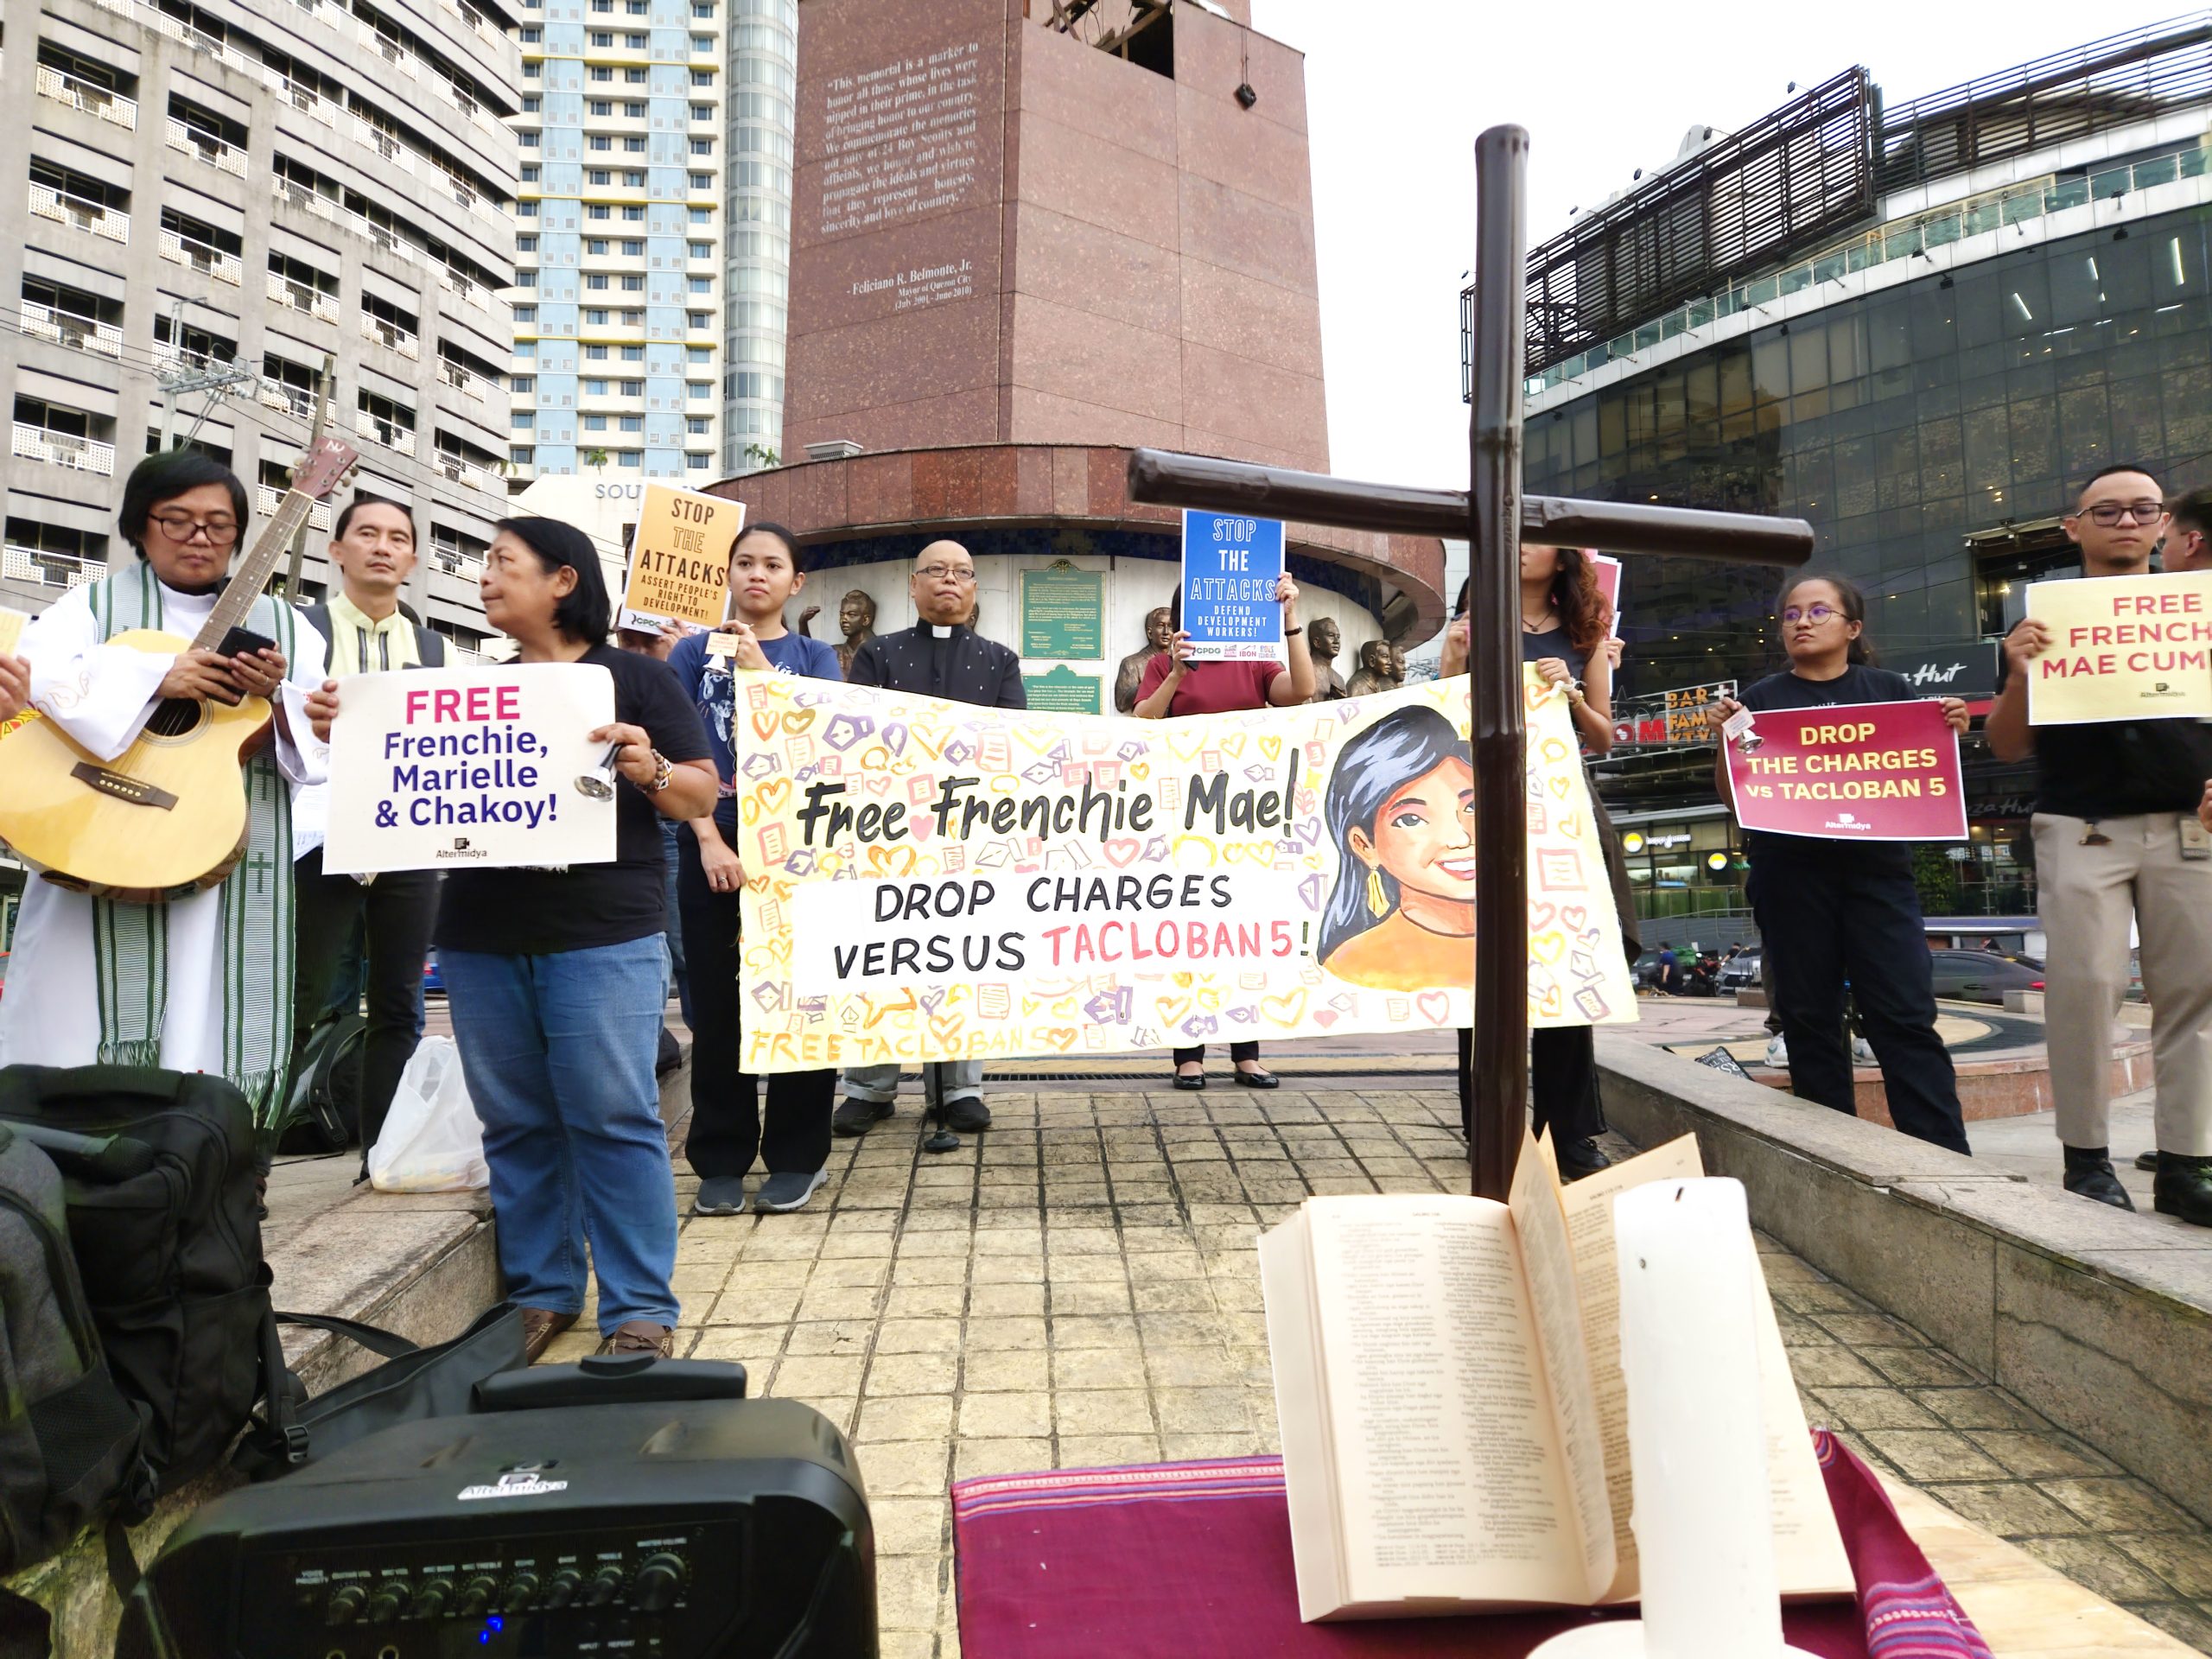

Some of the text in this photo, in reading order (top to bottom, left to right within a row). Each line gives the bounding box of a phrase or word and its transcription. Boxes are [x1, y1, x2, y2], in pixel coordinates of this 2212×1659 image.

[858, 61, 900, 84] memorial
[906, 59, 912, 70] is
[918, 58, 923, 67] a
[929, 46, 964, 64] marker
[969, 42, 978, 53] to
[827, 58, 977, 109] honor all those whose lives were
[826, 105, 856, 124] nipped
[860, 103, 868, 115] in
[871, 97, 892, 111] their
[928, 84, 937, 96] in
[940, 79, 954, 92] the
[957, 73, 977, 86] task
[826, 127, 835, 140] of
[836, 118, 875, 137] bringing
[878, 110, 905, 125] honor
[907, 106, 916, 118] to
[918, 102, 934, 114] our
[826, 106, 976, 155] We commemorate the memories
[824, 157, 839, 170] not
[868, 145, 877, 158] of
[899, 138, 915, 151] Boy
[921, 127, 952, 144] Scouts
[957, 120, 976, 136] and
[867, 162, 880, 175] we
[884, 155, 912, 171] honor
[917, 147, 934, 162] and
[939, 140, 961, 156] wish
[965, 138, 976, 149] to
[823, 155, 975, 205] propagate the ideals and virtues
[823, 204, 841, 217] that
[847, 197, 866, 212] they
[874, 185, 918, 207] represent
[821, 216, 861, 235] sincerity
[864, 208, 881, 224] and
[885, 204, 904, 219] love
[907, 199, 918, 213] of
[853, 278, 893, 295] Feliciano
[897, 273, 906, 285] R.
[959, 258, 972, 272] Jr.
[899, 276, 972, 297] Mayor of Quezon City
[671, 498, 715, 525] STOP
[673, 526, 705, 553] THE
[1213, 518, 1256, 543] STOP
[640, 549, 725, 587] ATTACKS
[1218, 550, 1249, 571] THE
[641, 575, 718, 601] ASSERT PEOPLE'S
[658, 589, 698, 606] RIGHT TO
[1191, 578, 1276, 601] ATTACKS
[644, 596, 709, 620] DEVELOPMENT!
[1215, 606, 1250, 615] DEFEND
[2113, 594, 2202, 616] FREE
[1198, 617, 1267, 626] DEVELOPMENT
[1207, 627, 1257, 637] WORKERS!
[1914, 663, 1967, 686] Hut
[2044, 651, 2205, 679] MAE CUM
[406, 686, 521, 724] FREE
[1669, 688, 1708, 709] BAR
[385, 724, 548, 760] Frenchie,
[1801, 722, 1877, 746] DROP
[393, 759, 538, 792] Marielle
[1746, 748, 1938, 775] THE CHARGES
[796, 748, 1300, 848] Free Frenchie Mae!
[1778, 779, 1922, 800] TACLOBAN
[1929, 778, 1946, 796] 5
[375, 794, 557, 829] & Chakoy!
[1825, 820, 1872, 830] Altermidya
[435, 848, 487, 859] Altermidya
[874, 874, 1233, 923] DROP CHARGES
[835, 931, 1027, 980] VERSUS
[749, 1027, 841, 1065] FREE
